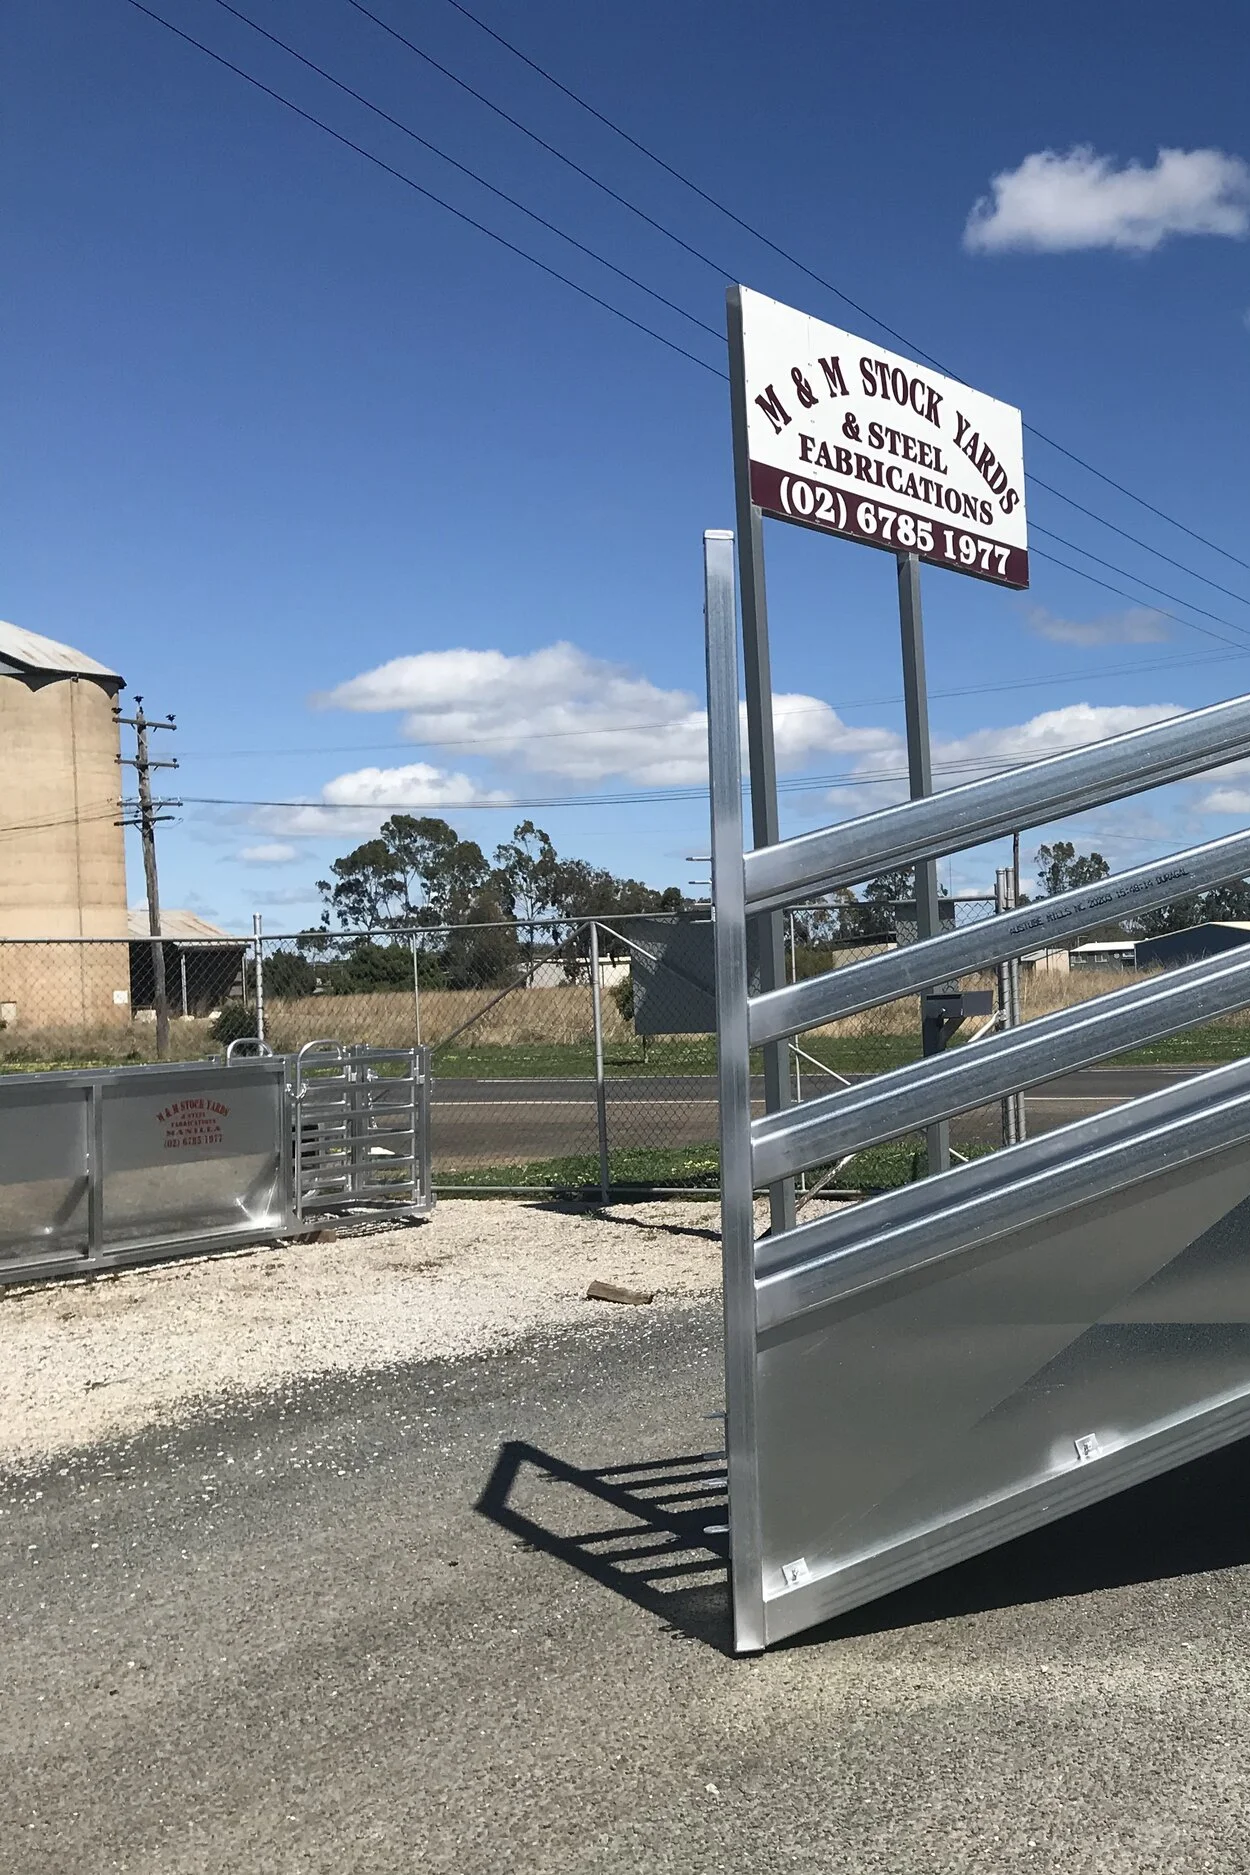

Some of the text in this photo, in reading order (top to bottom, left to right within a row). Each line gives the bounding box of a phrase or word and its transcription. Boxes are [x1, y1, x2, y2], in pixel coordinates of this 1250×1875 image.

[755, 356, 1020, 515] M & M STOCK YARDS
[798, 433, 994, 526] FABRICATIONS
[842, 412, 948, 475] & STEEL
[780, 476, 1011, 575] (02) 6785 1977
[1046, 909, 1072, 922] MILLS
